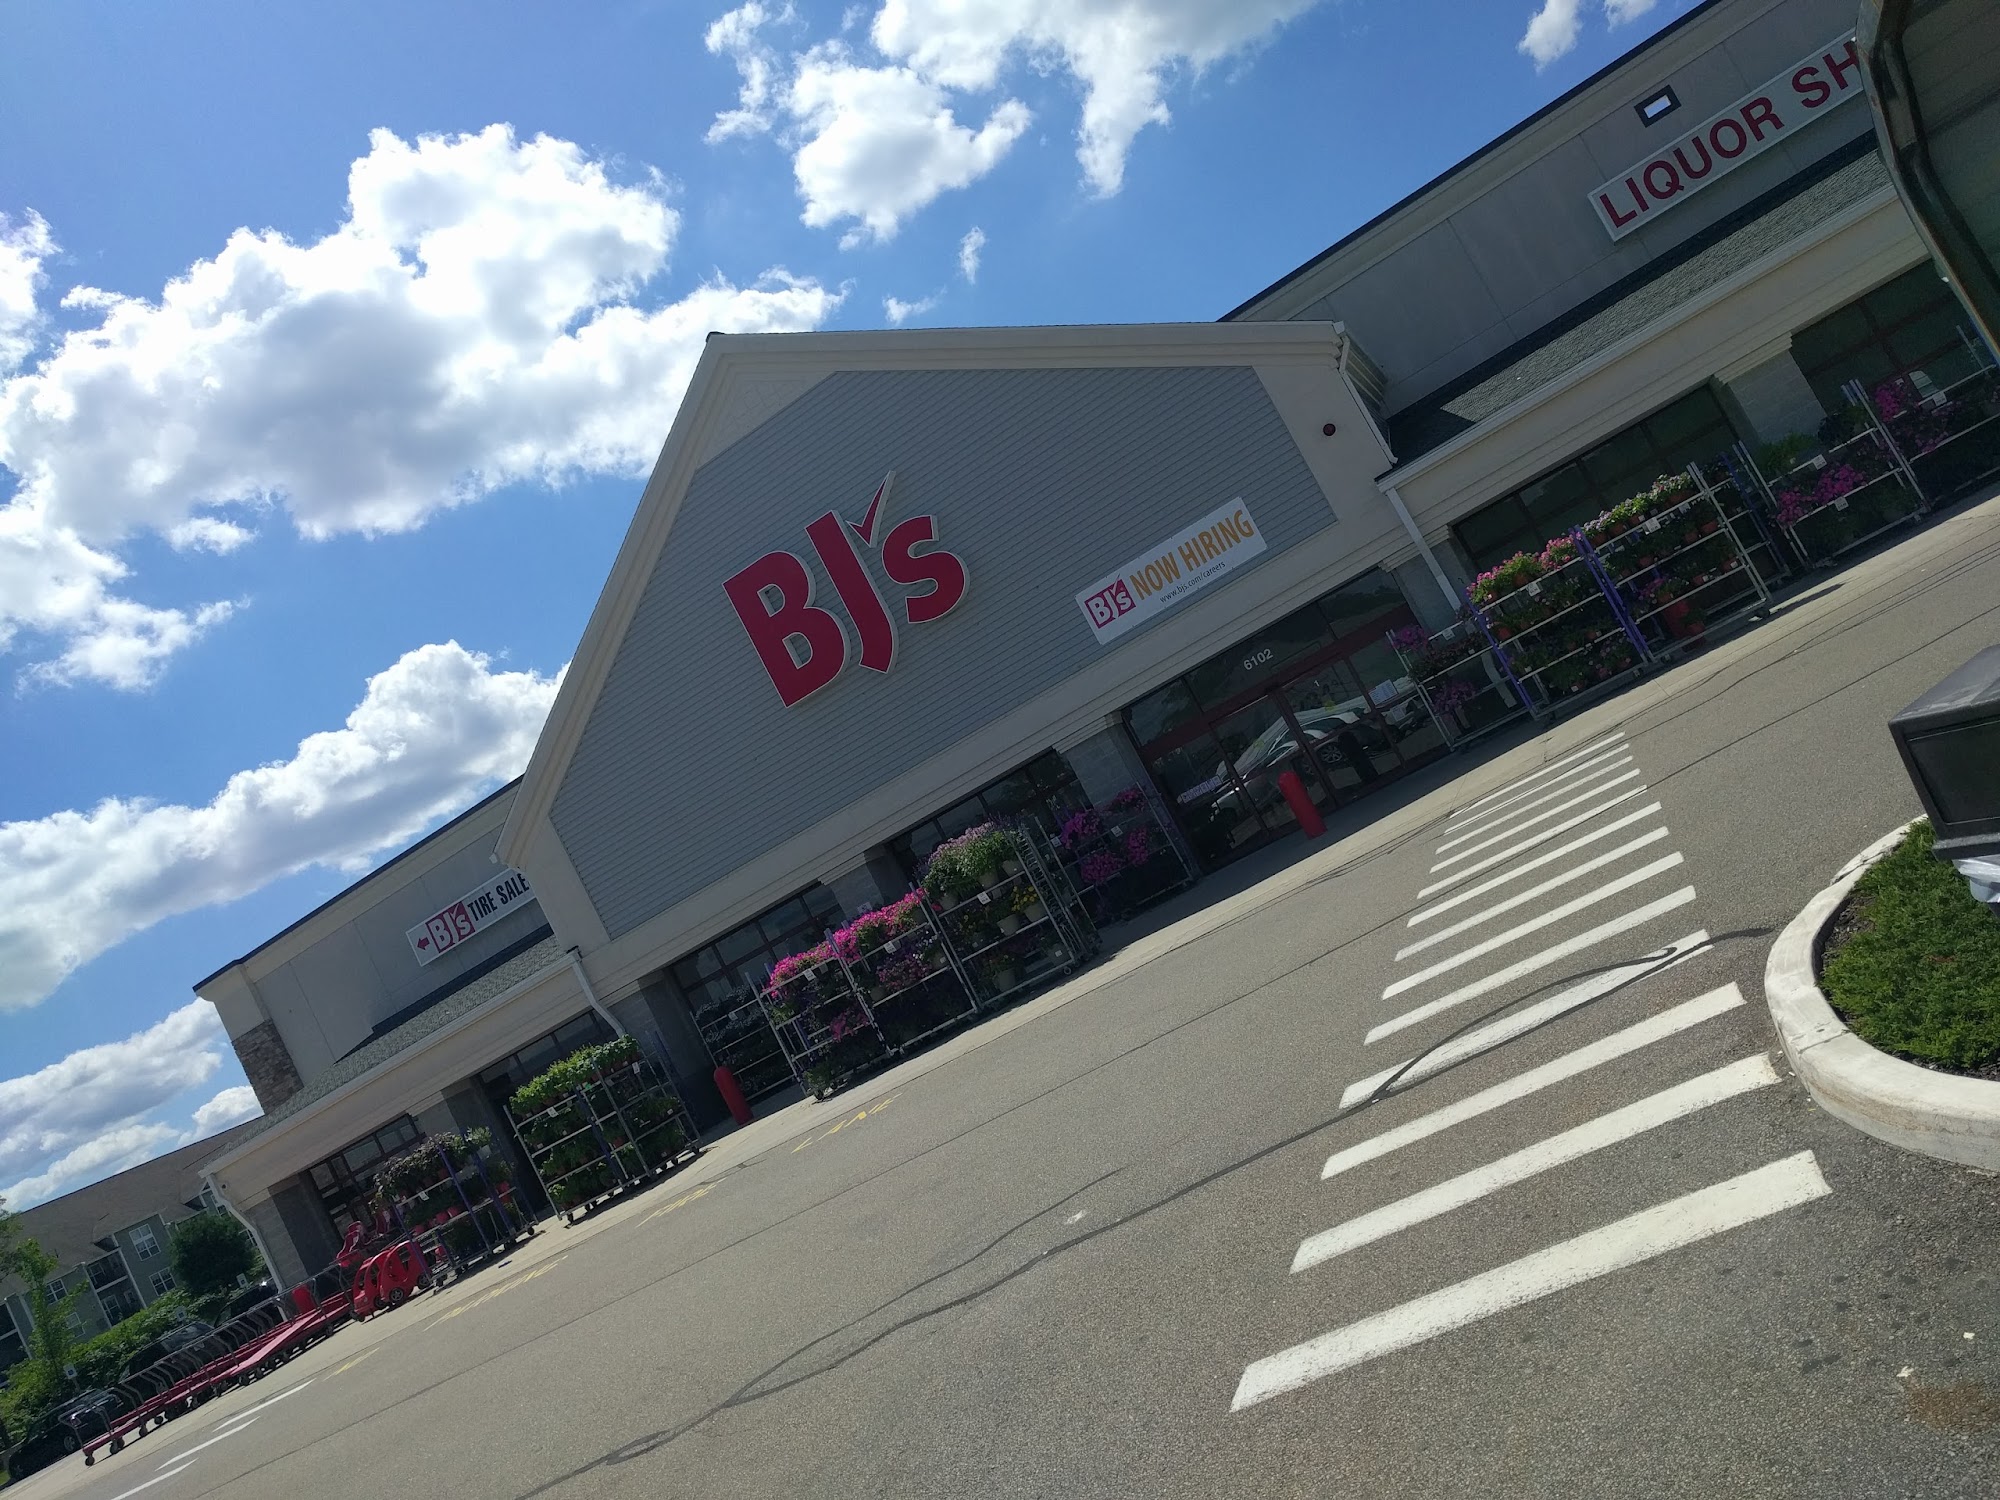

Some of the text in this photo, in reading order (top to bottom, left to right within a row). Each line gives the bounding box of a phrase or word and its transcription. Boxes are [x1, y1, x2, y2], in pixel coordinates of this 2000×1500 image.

[1600, 97, 1785, 228] LIQUOR
[1129, 551, 1181, 600] NOW
[1177, 509, 1255, 571] HIRING
[1159, 561, 1226, 603] www.bjs.com/careers
[1243, 648, 1274, 670] 6102
[467, 891, 498, 922] TIRE
[495, 873, 530, 905] SALE
